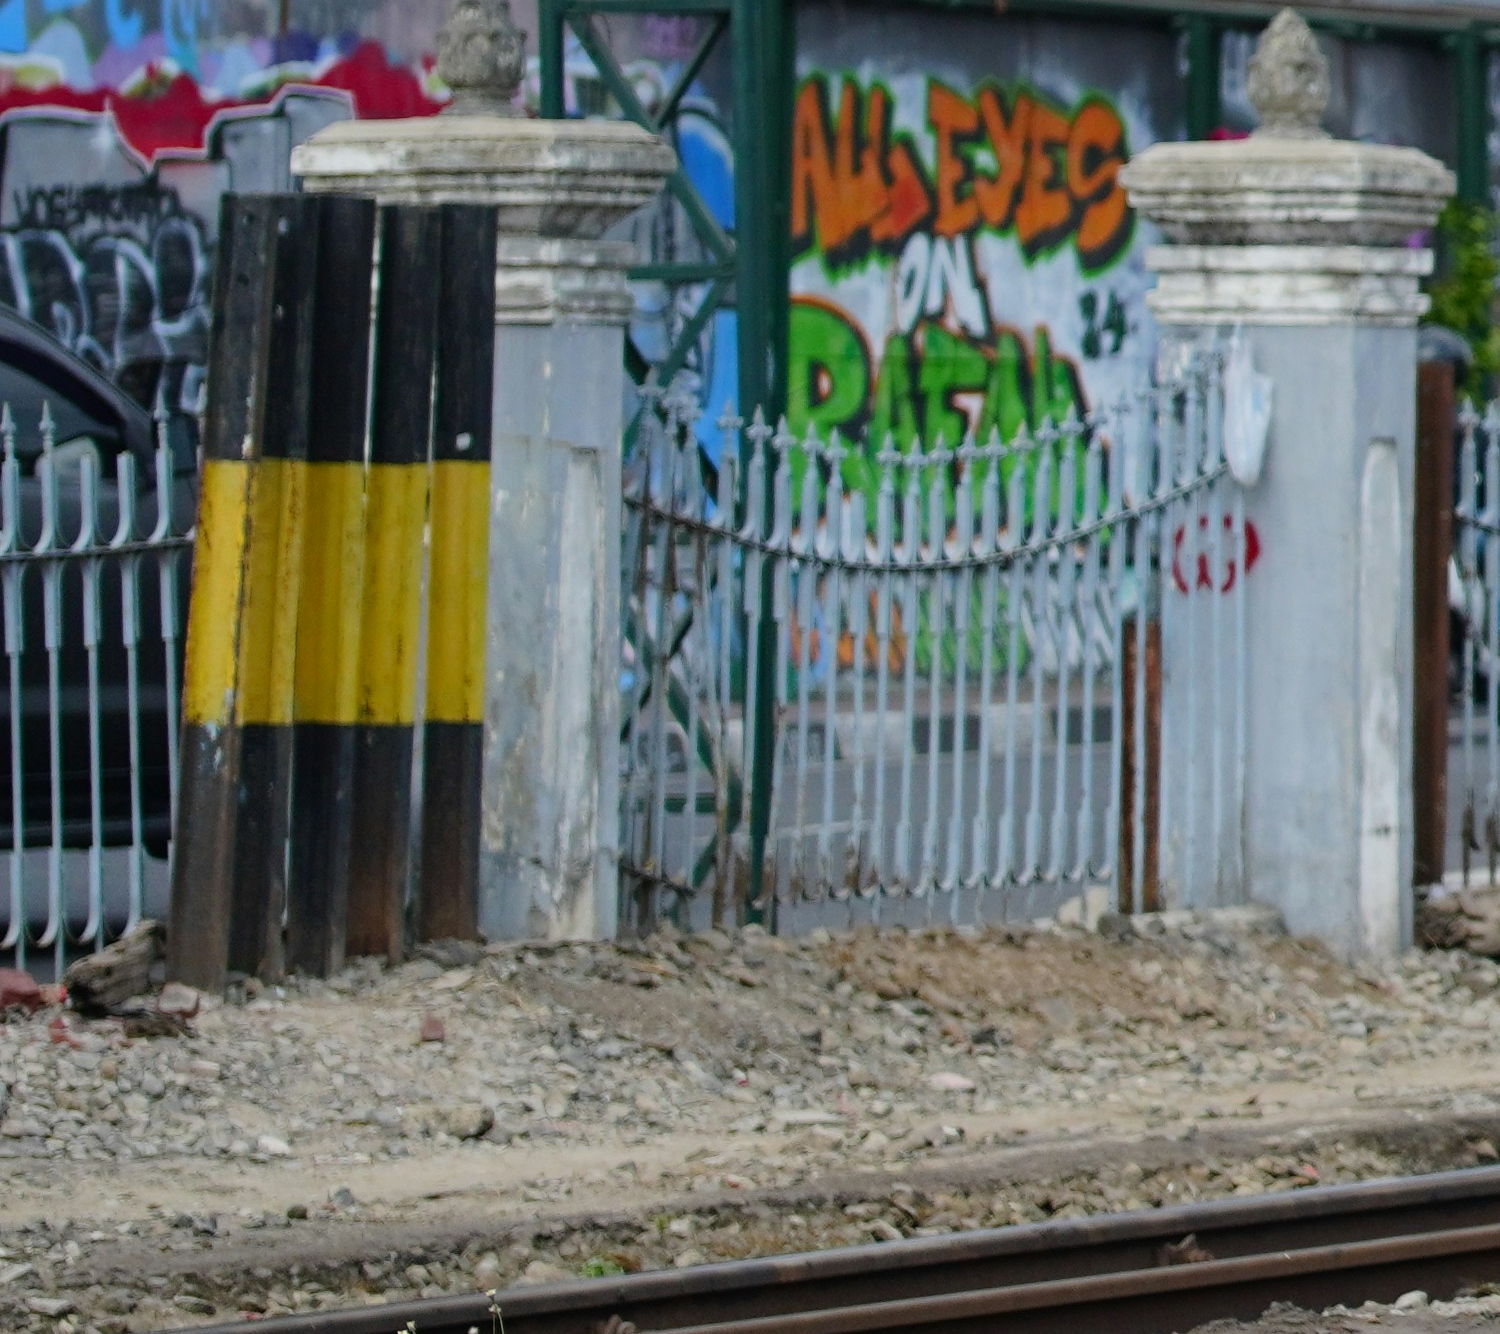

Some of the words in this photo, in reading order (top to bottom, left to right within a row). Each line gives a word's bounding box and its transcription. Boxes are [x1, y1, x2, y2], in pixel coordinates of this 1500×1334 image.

[790, 79, 932, 255] ALL
[925, 79, 1128, 259] EYES
[895, 230, 992, 345] ON
